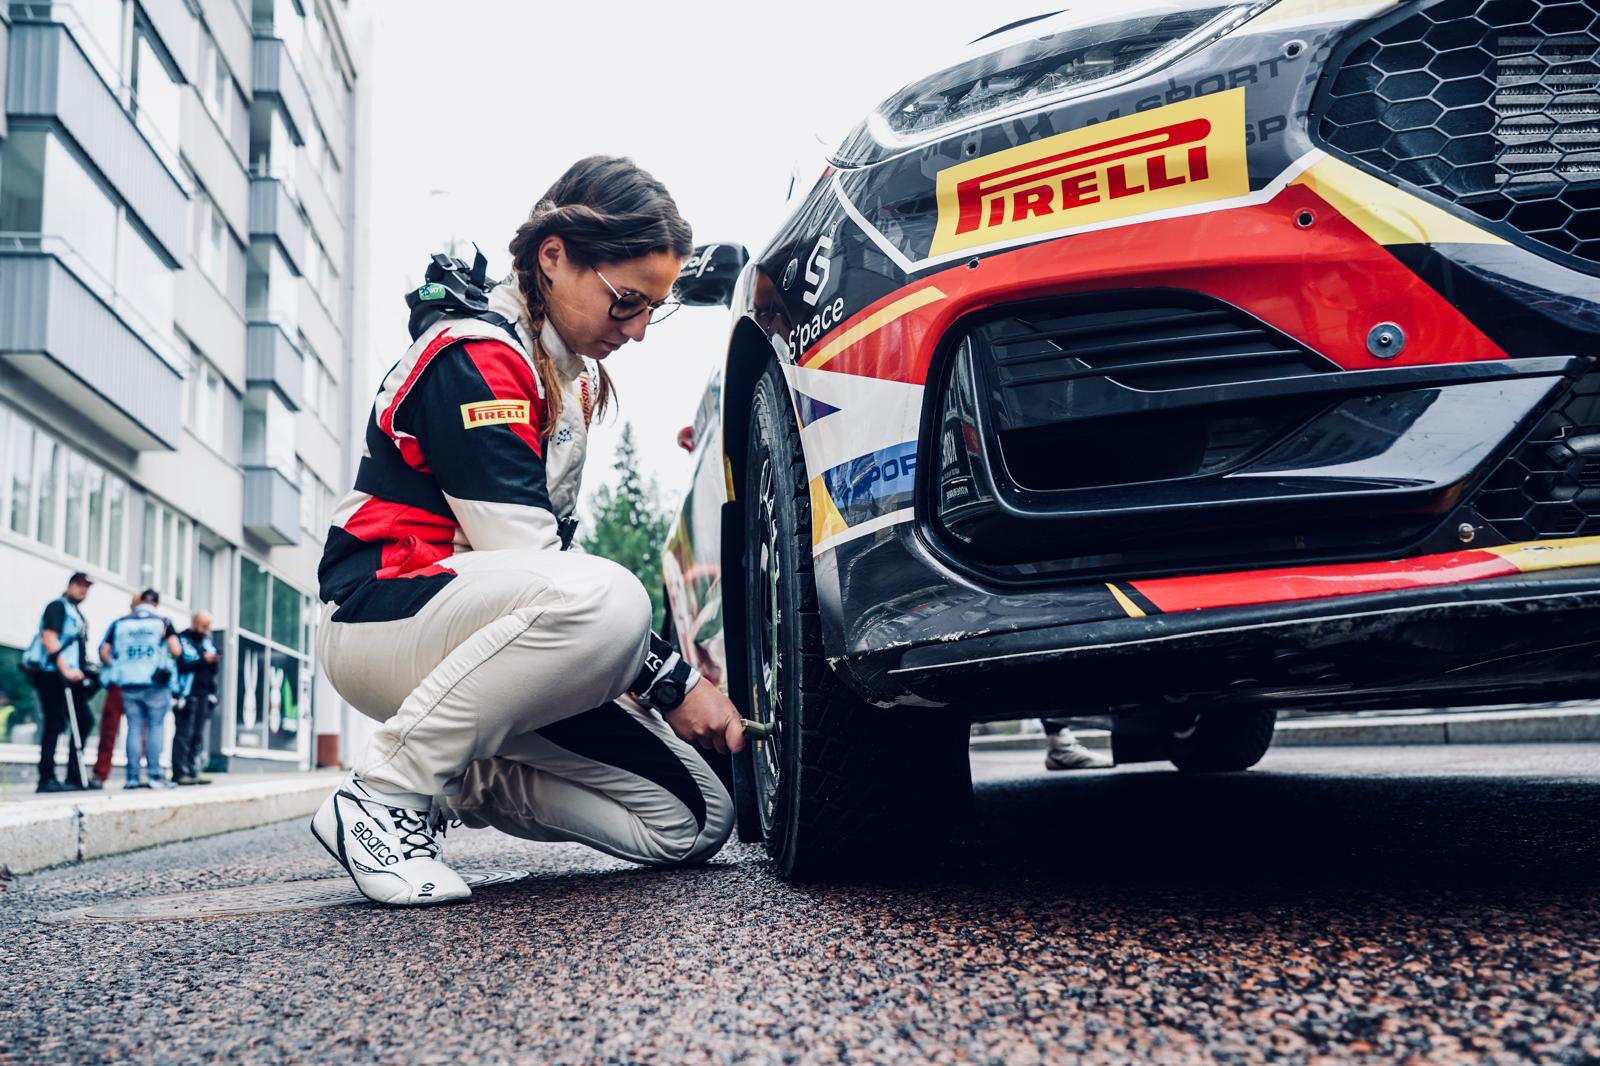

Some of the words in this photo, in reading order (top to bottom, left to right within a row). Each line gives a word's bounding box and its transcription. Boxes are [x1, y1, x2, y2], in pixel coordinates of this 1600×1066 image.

[955, 118, 1212, 236] PIRELLI
[468, 405, 525, 422] PIRELLI
[351, 821, 399, 867] sparco
